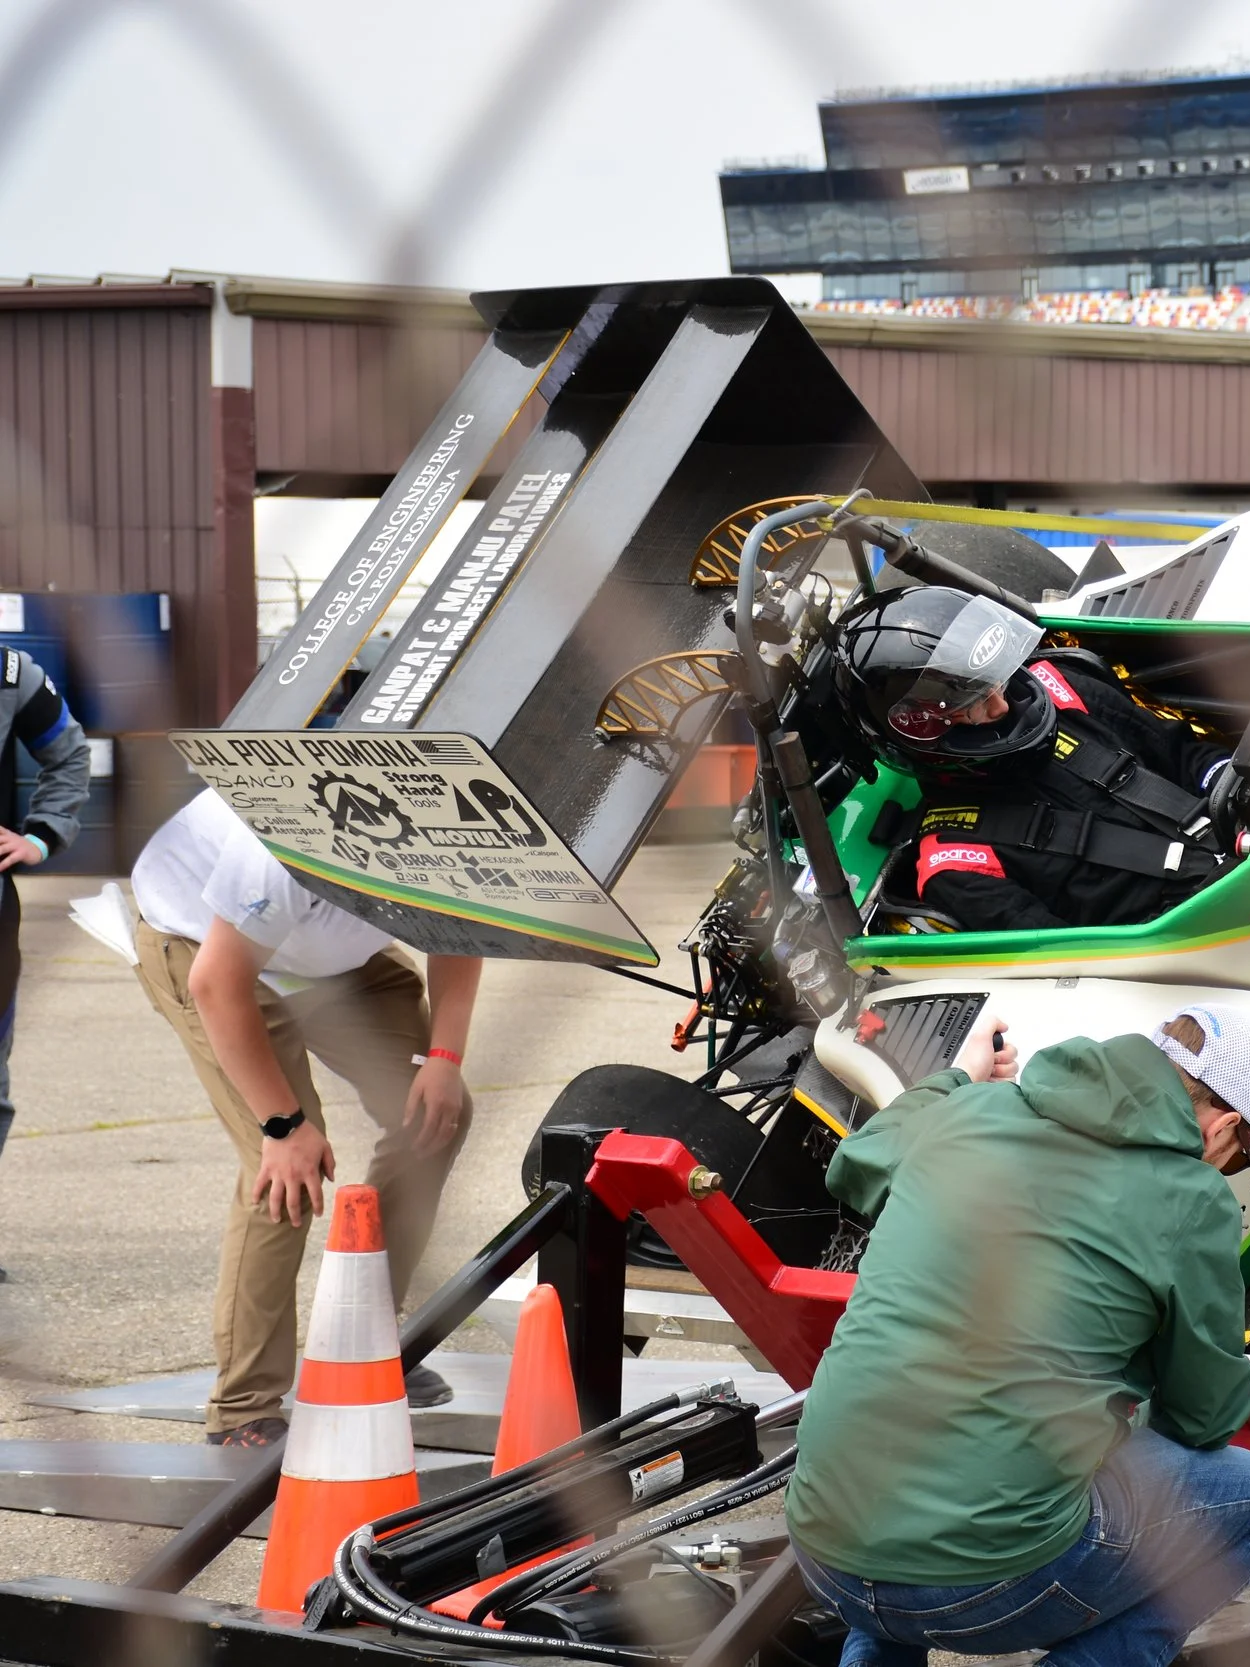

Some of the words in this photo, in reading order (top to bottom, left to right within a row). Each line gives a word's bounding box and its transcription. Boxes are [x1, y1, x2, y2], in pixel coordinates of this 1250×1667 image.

[279, 591, 354, 685] COLLEGE
[348, 557, 375, 590] OF
[368, 413, 475, 555] ENGINEERING
[346, 589, 376, 626] CAL
[371, 547, 406, 597] POLY
[402, 468, 461, 546] POMONA
[361, 637, 433, 724] GANPAT
[422, 617, 451, 634] &
[442, 537, 502, 612] MANJU
[487, 470, 553, 537] PATEL
[392, 653, 452, 723] STUDENT
[439, 586, 498, 655] PROJECT
[493, 472, 572, 583] LABORATORIES
[1181, 580, 1206, 620] TORSPORTS
[1166, 600, 1180, 620] ONCO
[975, 626, 1004, 665] HJC
[172, 740, 239, 766] CAL
[227, 740, 305, 766] POLY
[299, 740, 428, 766] POMONA
[206, 774, 294, 788] DANCO
[382, 771, 448, 786] Strong
[393, 784, 446, 796] Hand
[404, 798, 441, 808] Tools
[264, 817, 301, 825] Collins
[273, 826, 327, 836] Aerospace
[427, 829, 506, 847] MOTUL
[400, 853, 457, 868] BRAVO
[480, 856, 526, 865] HEXAGON
[526, 869, 585, 884] YAMAHA
[533, 890, 602, 903] aria
[939, 1006, 958, 1037] BRONCO
[942, 1006, 975, 1059] MOTORSPORTS
[544, 1559, 591, 1589] www.parker.com
[568, 1641, 616, 1654] www.parker.com
